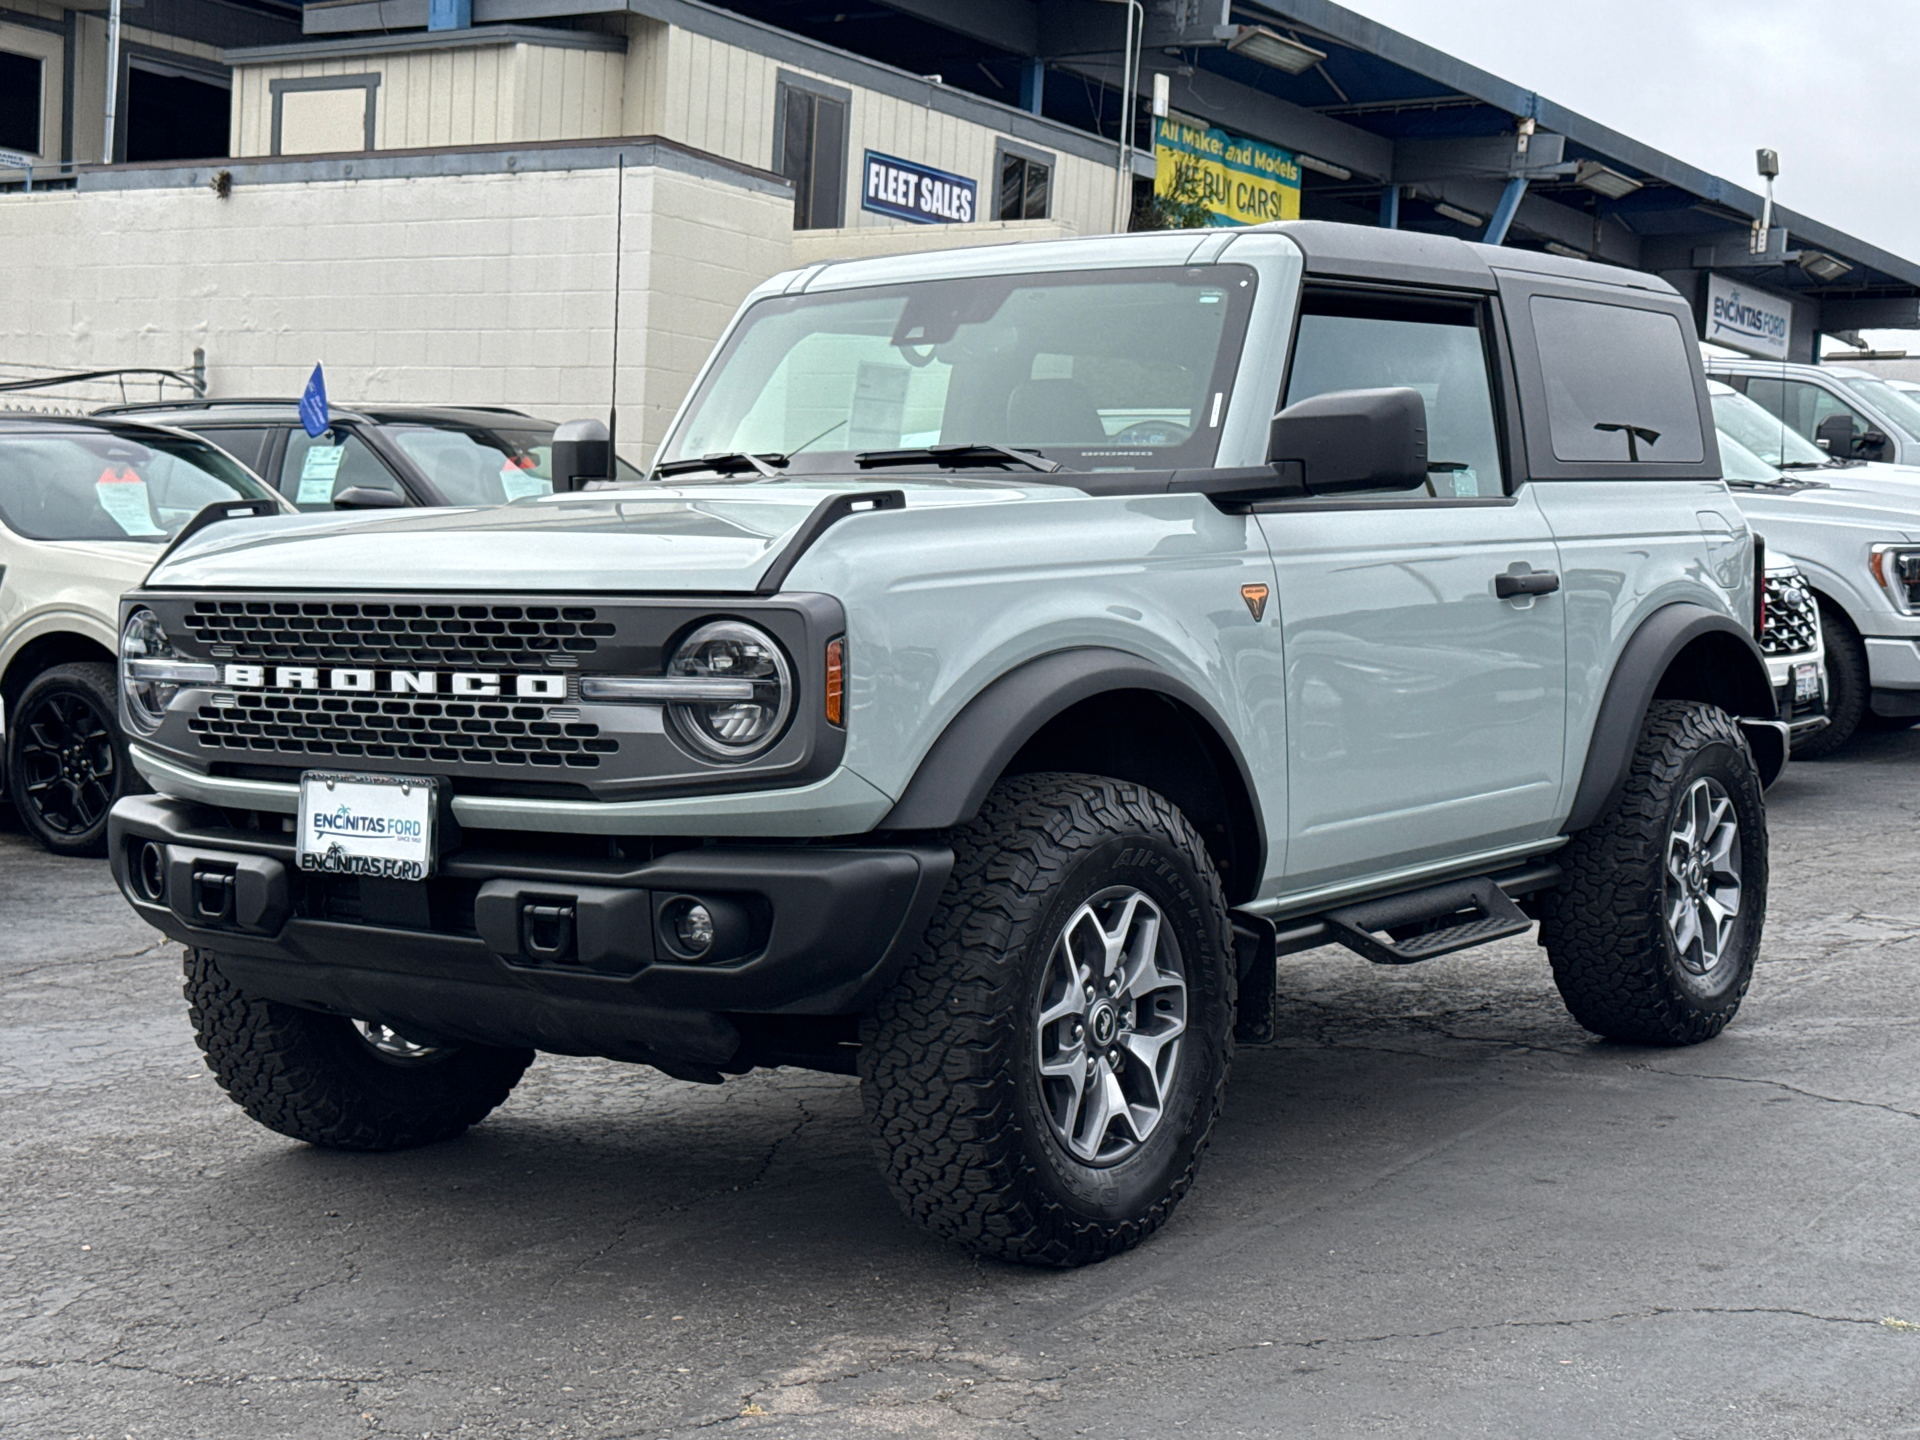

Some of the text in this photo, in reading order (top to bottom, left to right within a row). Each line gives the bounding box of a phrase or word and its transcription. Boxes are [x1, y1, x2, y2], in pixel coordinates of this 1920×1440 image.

[1160, 119, 1179, 142] All
[1225, 145, 1251, 166] and
[1254, 151, 1298, 181] Models
[868, 162, 972, 222] FLEET SALES
[1203, 166, 1232, 209] BUY
[1236, 182, 1283, 219] CARS!
[1713, 296, 1786, 338] ENCINITAS FORD
[225, 663, 567, 698] BRONCO
[313, 812, 421, 837] ENCINITAS FORD
[302, 853, 422, 880] ENCINITAS FORD
